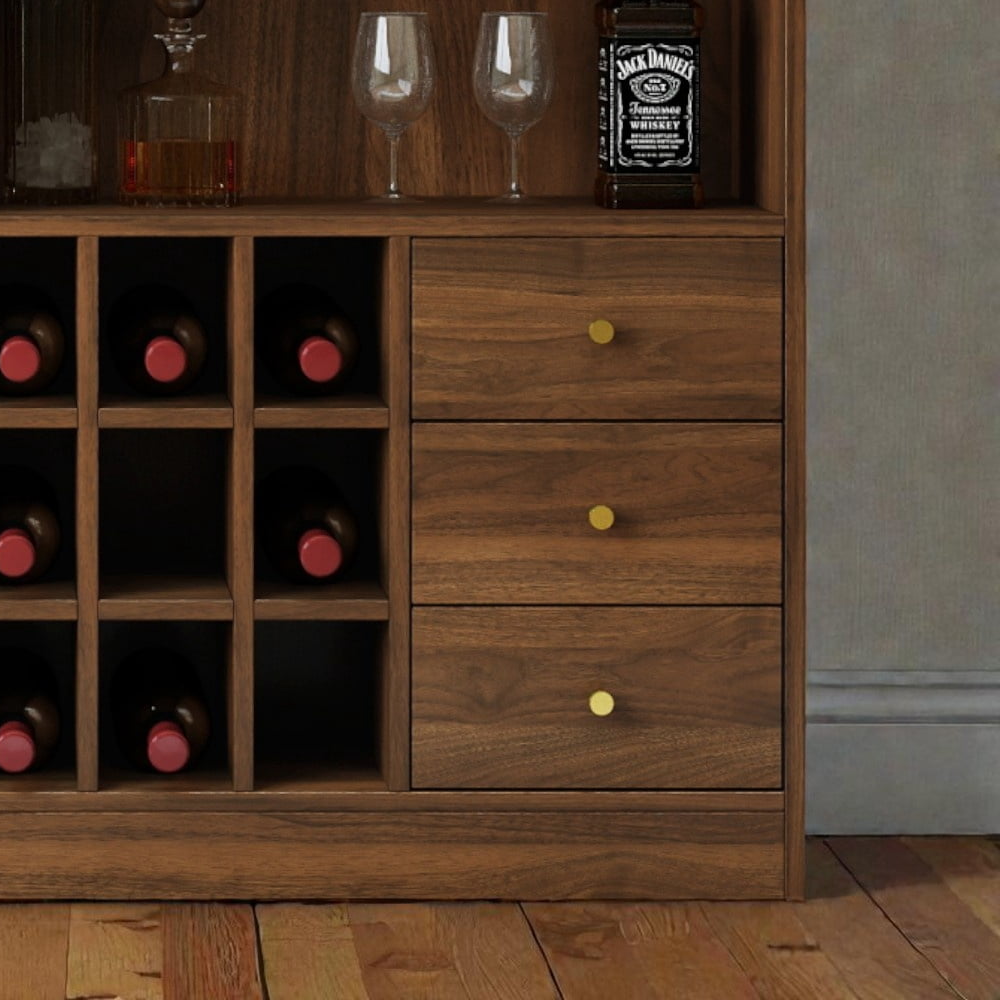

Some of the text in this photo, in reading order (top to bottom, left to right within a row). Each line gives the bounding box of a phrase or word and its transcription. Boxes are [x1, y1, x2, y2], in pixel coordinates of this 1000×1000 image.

[616, 53, 646, 80] JACK
[629, 101, 681, 115] Tennessee
[630, 120, 680, 131] WHISKEY
